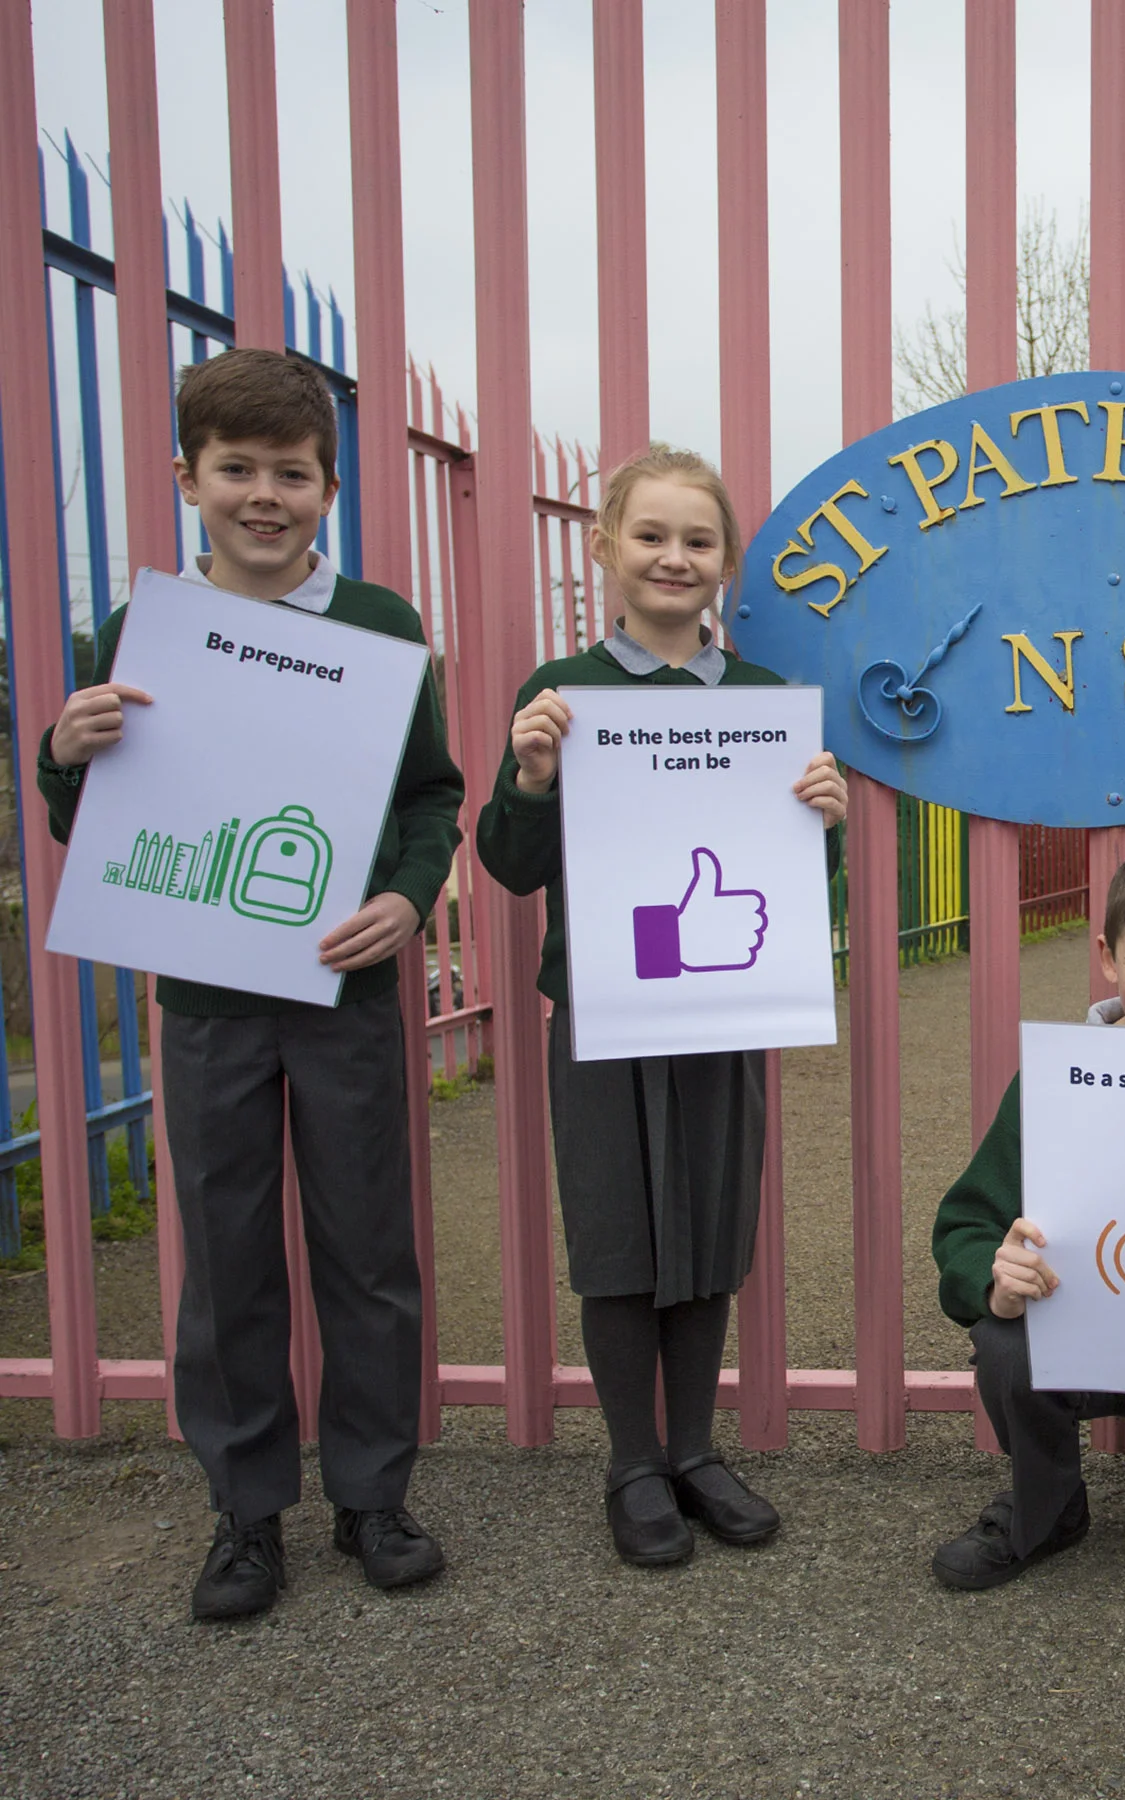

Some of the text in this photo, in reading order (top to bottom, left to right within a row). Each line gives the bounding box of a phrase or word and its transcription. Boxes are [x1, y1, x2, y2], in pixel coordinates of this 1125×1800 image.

[771, 479, 890, 618] ST
[205, 631, 345, 684] Be prepared
[1001, 630, 1083, 713] N
[597, 727, 788, 749] Be the best person
[652, 752, 731, 771] I can be
[1069, 1066, 1096, 1086] Be
[1100, 1073, 1113, 1088] a
